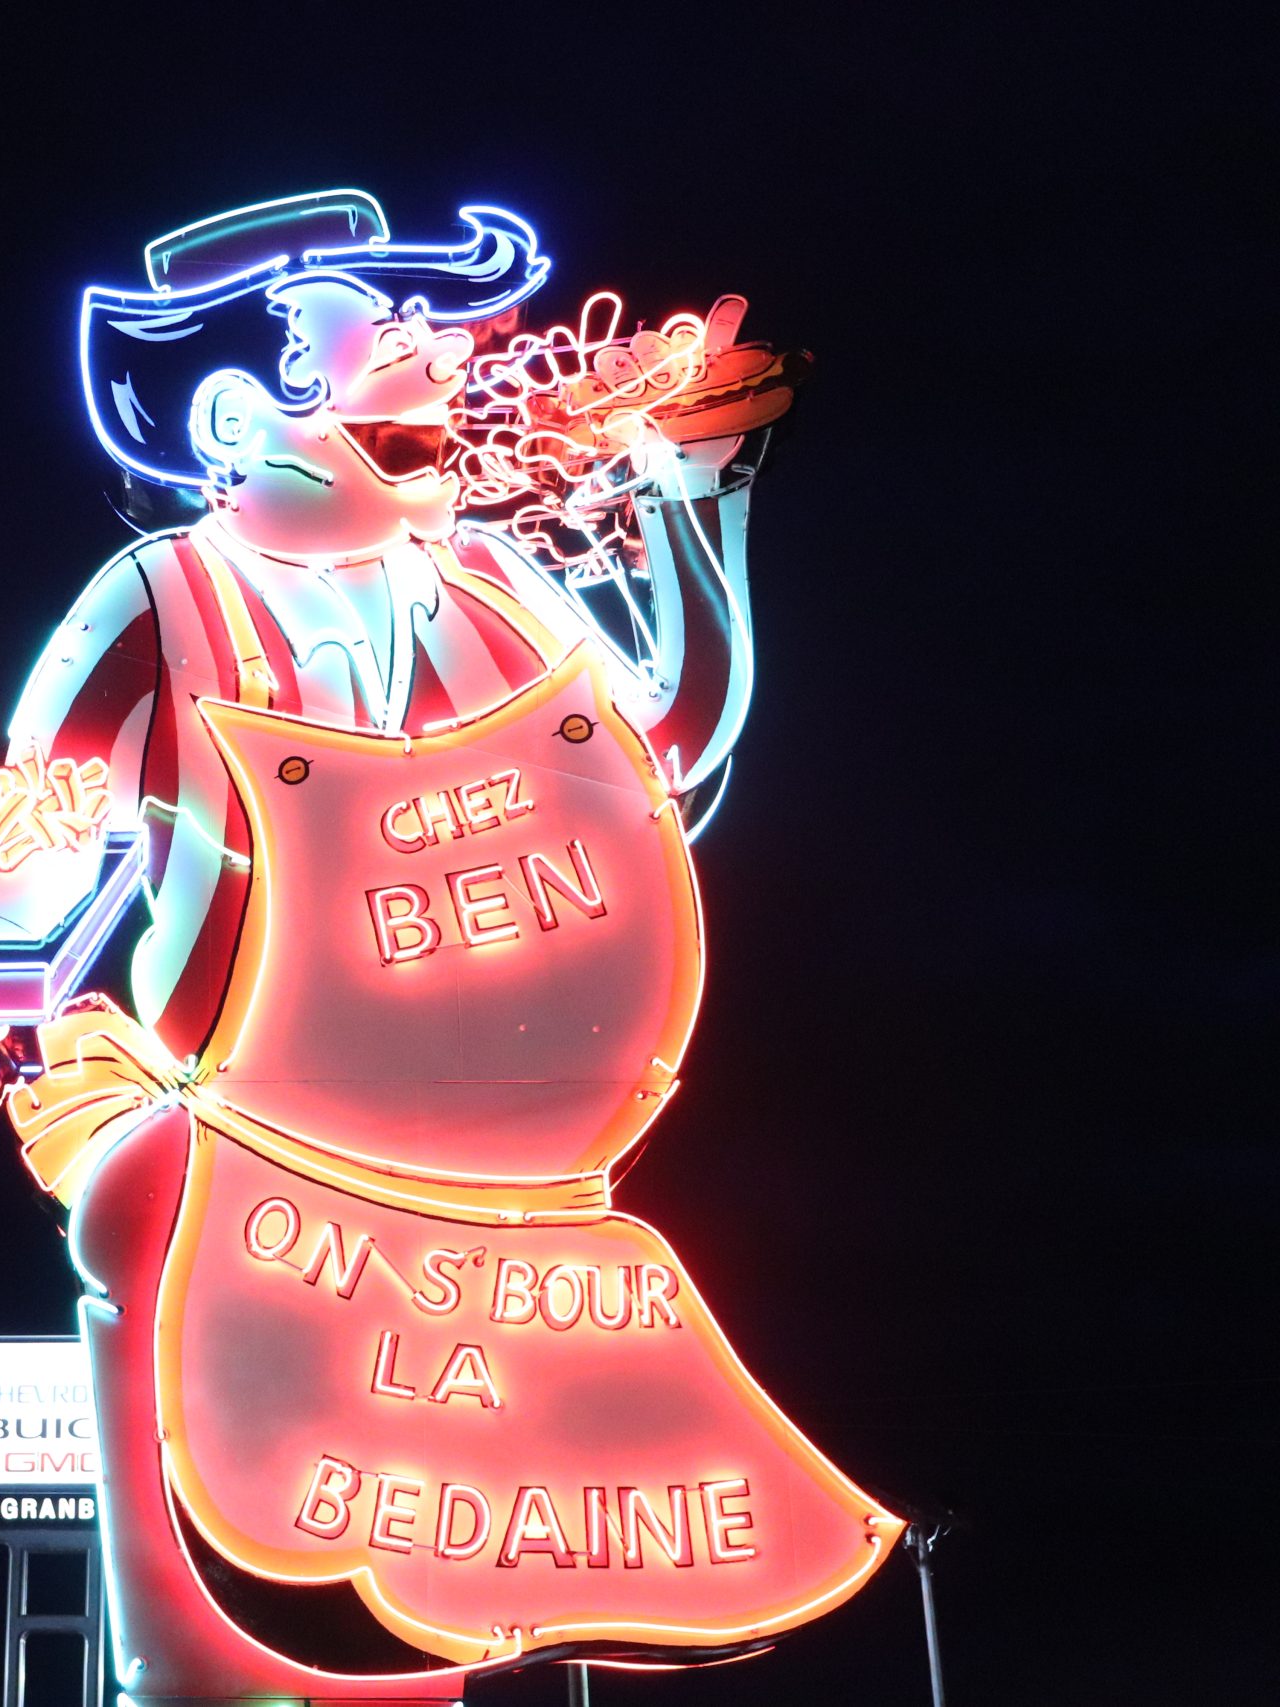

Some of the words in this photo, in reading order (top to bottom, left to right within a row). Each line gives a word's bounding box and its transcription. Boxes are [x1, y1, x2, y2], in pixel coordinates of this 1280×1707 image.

[380, 767, 535, 854] CHEZ
[364, 839, 608, 968] BEN
[244, 1196, 375, 1300] ON
[370, 1328, 505, 1410] LA
[4, 1452, 96, 1473] GMC
[0, 1497, 96, 1520] GRANB
[295, 1453, 759, 1569] BEDAINE
